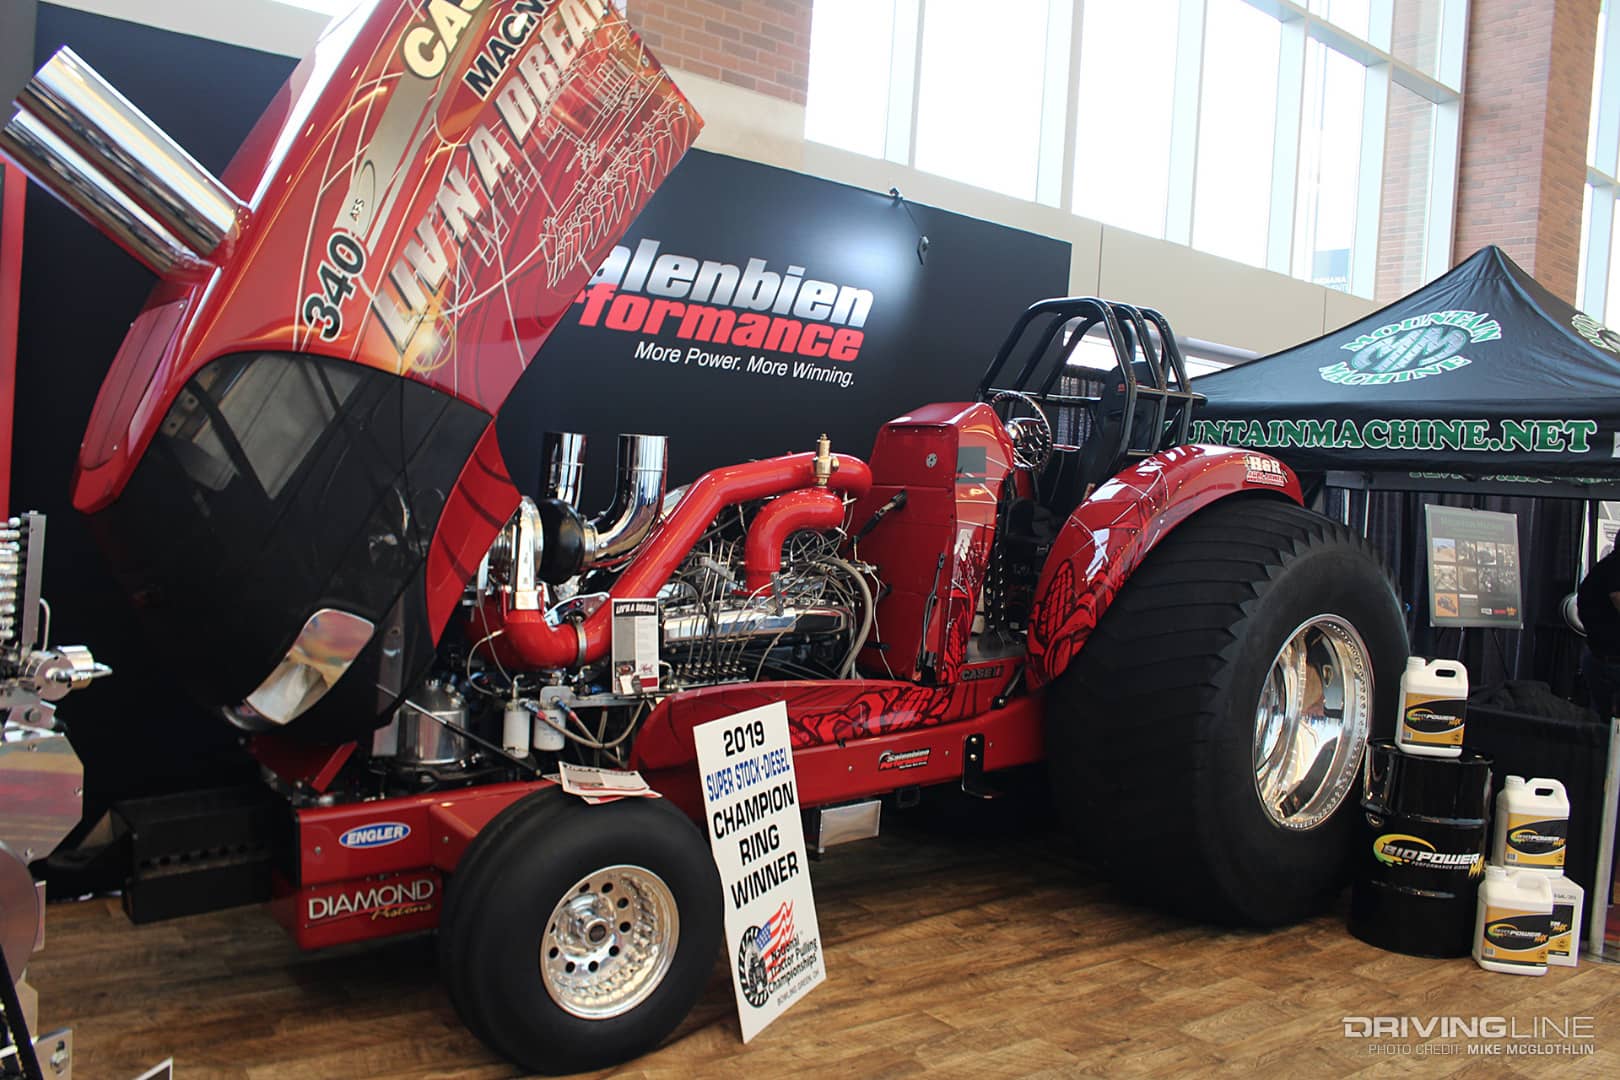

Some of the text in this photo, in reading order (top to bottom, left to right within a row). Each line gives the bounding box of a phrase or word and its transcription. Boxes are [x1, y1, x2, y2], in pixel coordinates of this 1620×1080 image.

[350, 198, 364, 222] AFS
[303, 231, 366, 342] 340
[575, 283, 865, 362] formance
[1340, 310, 1502, 353] MOUNTAIN
[634, 341, 855, 388] More Power. More Winning.
[1318, 355, 1473, 386] MACHINE
[723, 720, 765, 756] 2019
[706, 767, 735, 802] SUPER
[713, 781, 794, 839] CHAMPION
[346, 826, 404, 846] ENGLER
[739, 824, 780, 866] RING
[308, 879, 434, 919] DIAMOND
[730, 851, 799, 910] WINNER
[768, 952, 817, 994] Championships
